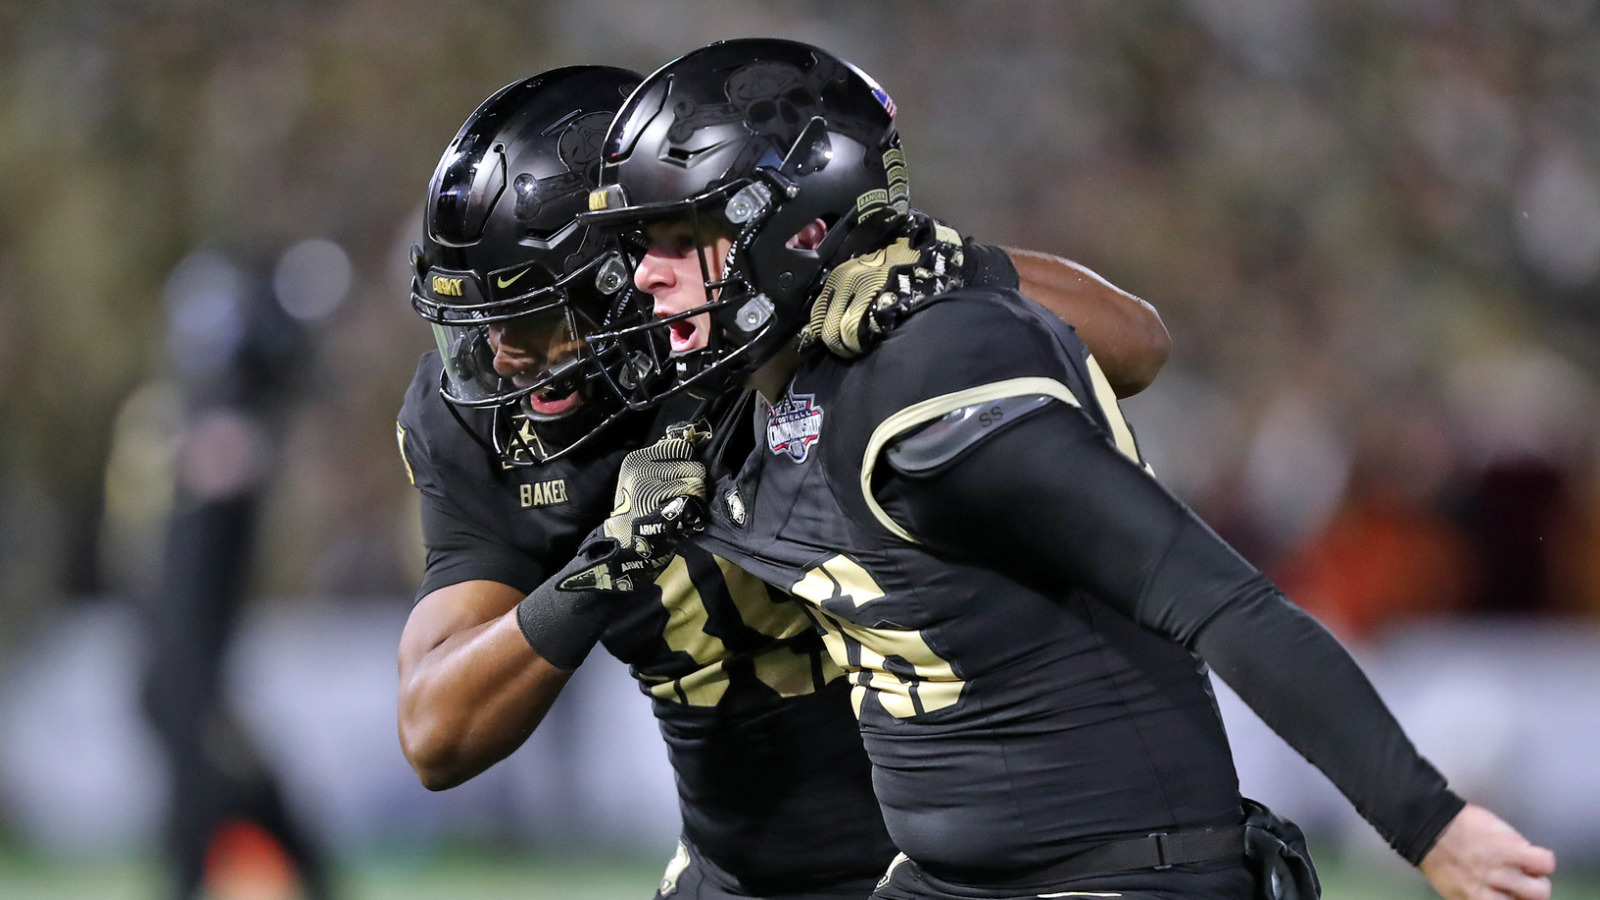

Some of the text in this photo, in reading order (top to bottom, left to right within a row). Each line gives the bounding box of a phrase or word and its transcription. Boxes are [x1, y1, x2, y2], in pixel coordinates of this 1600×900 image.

[432, 276, 463, 296] ARMY
[979, 406, 1003, 427] SS
[520, 479, 568, 507] BAKER
[639, 524, 662, 535] ARMY
[621, 561, 644, 572] ARMY
